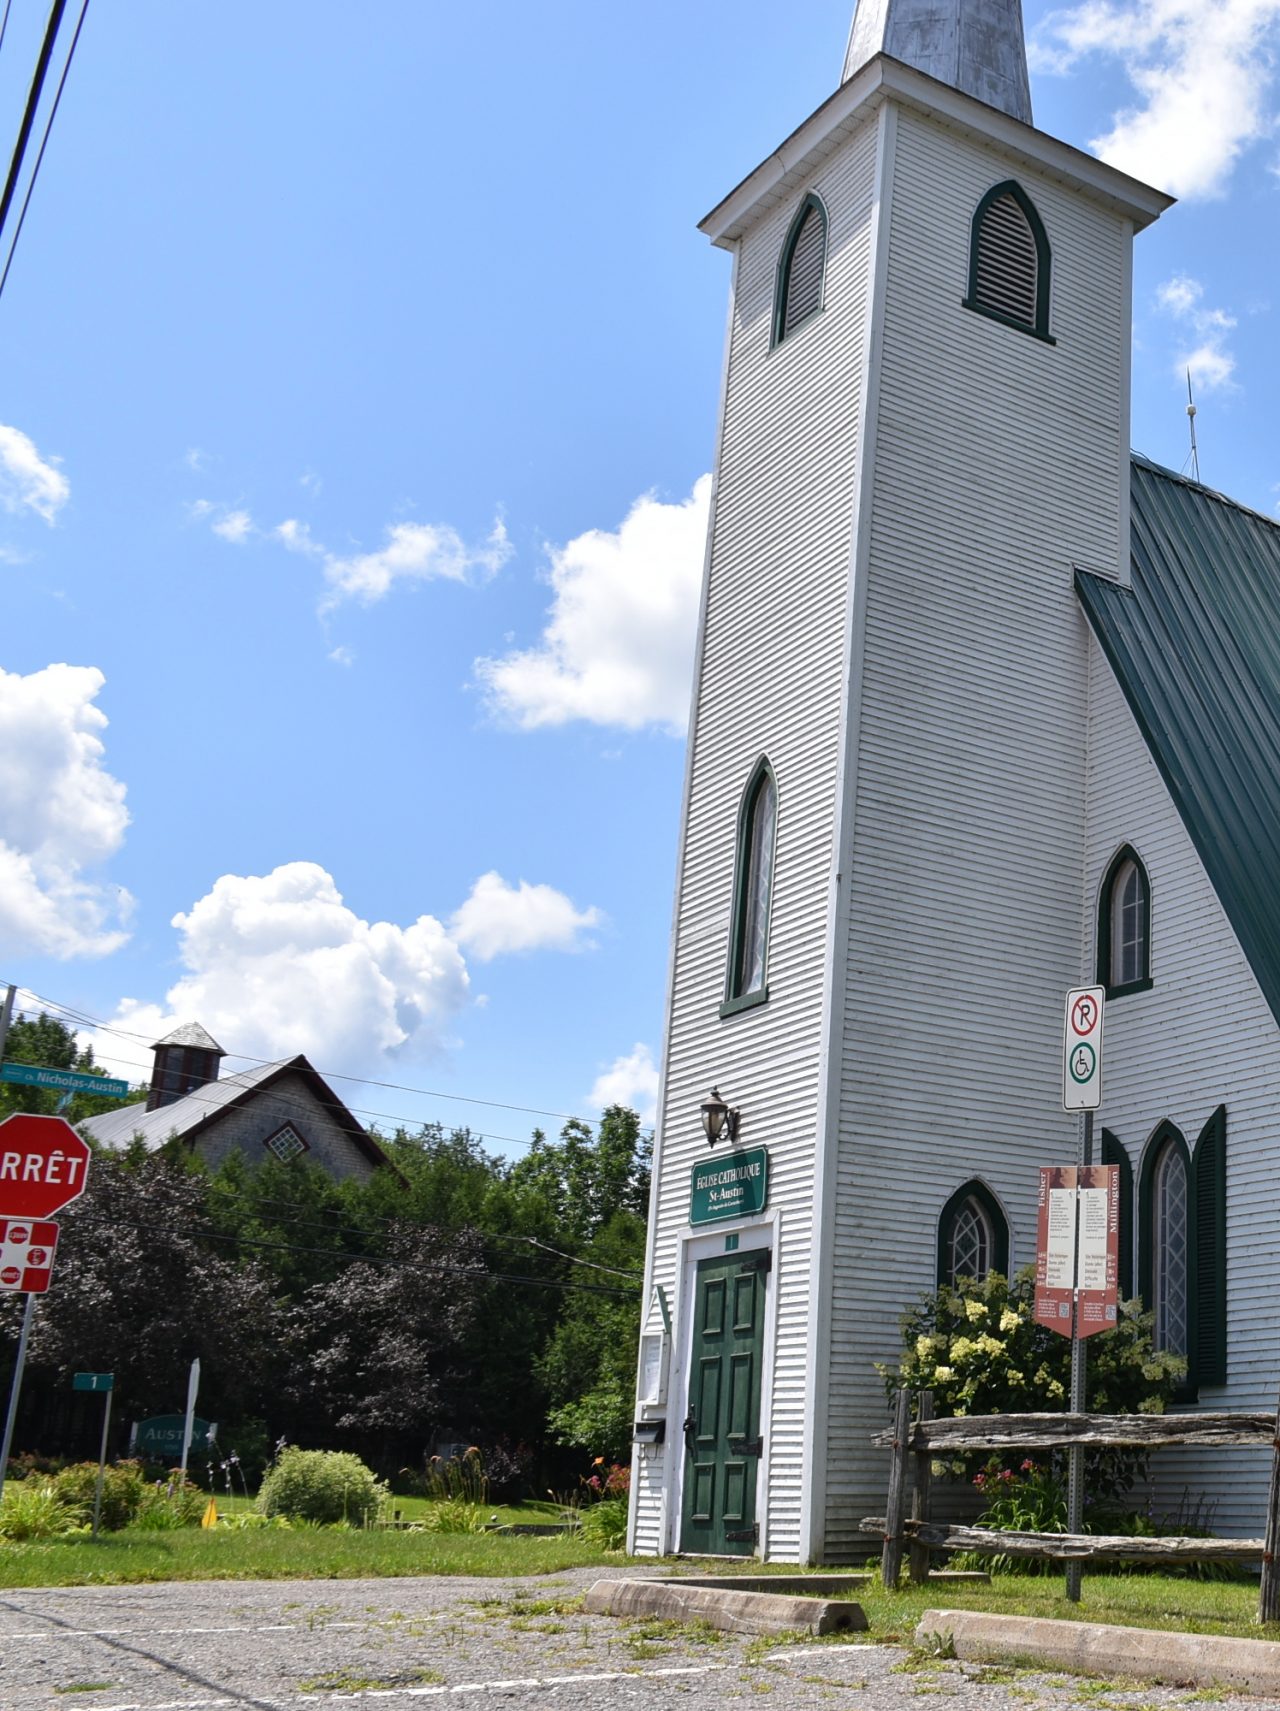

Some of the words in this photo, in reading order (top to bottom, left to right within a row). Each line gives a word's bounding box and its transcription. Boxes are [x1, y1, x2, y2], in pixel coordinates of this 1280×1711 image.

[37, 1071, 123, 1093] Nicholas-Austin
[0, 1149, 83, 1185] RRÊT
[718, 1162, 760, 1182] CATHOLIQUE
[1038, 1171, 1046, 1207] Fisher
[1109, 1171, 1119, 1233] Millington
[91, 1375, 98, 1389] 1
[144, 1427, 202, 1440] AUSTN
